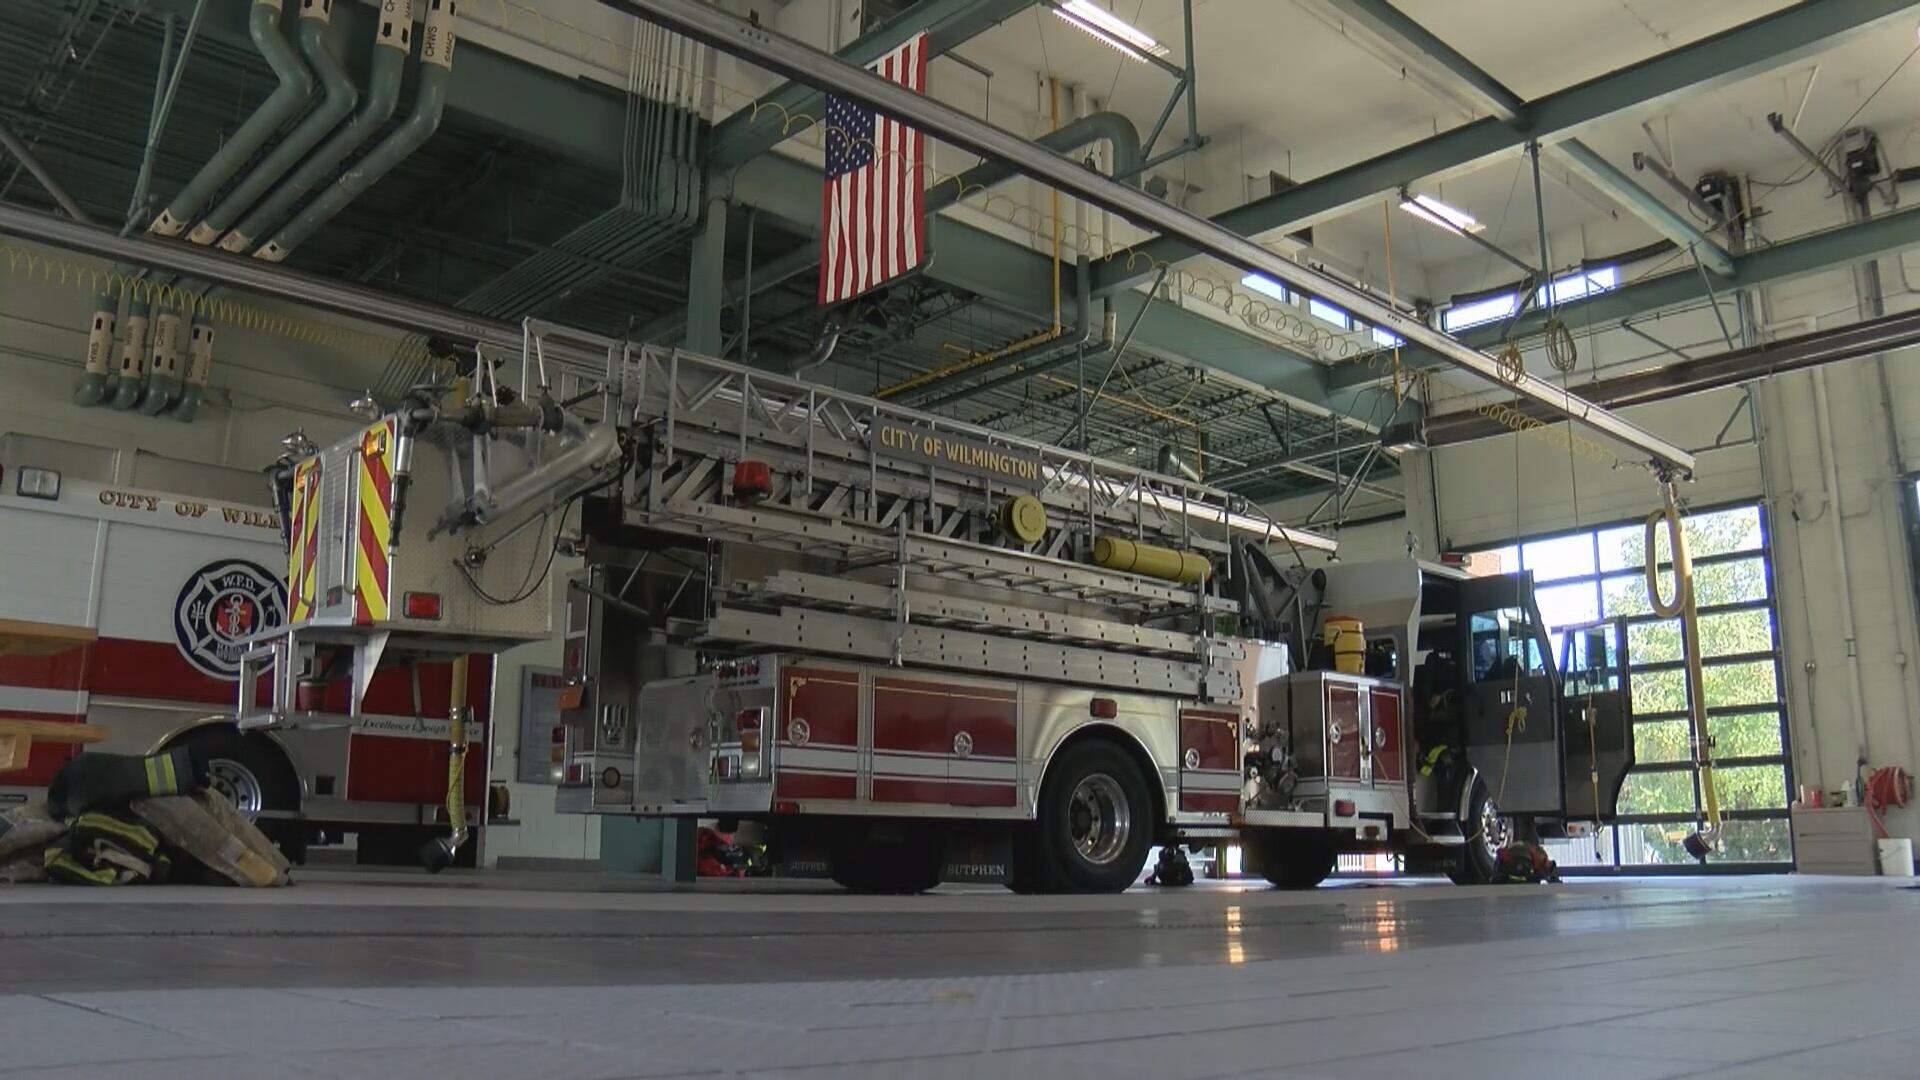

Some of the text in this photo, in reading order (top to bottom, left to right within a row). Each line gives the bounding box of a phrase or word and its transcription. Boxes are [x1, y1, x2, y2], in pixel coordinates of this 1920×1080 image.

[425, 26, 438, 57] CHWS
[90, 342, 100, 363] HWS
[881, 426, 1038, 480] CITY OF WILMINGTON
[99, 489, 161, 512] CITY
[175, 501, 208, 518] OF
[363, 719, 410, 733] Excellence
[947, 864, 1005, 877] SUTPHEN
